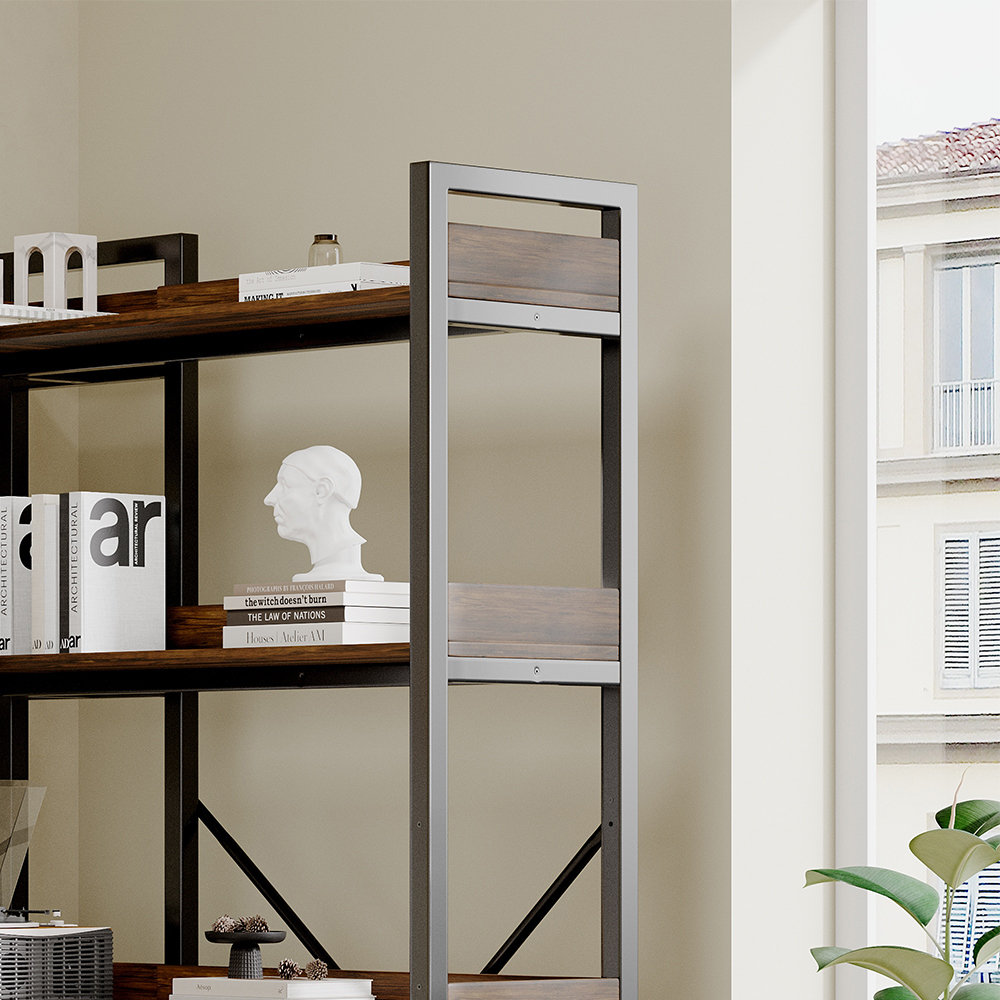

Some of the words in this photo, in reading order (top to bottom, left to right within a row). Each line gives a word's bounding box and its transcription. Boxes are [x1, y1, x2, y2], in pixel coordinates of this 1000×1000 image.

[90, 497, 161, 568] ar
[0, 506, 8, 616] ARCHITECTURAL
[70, 502, 78, 613] ARCHITECTURAL
[245, 598, 257, 607] the
[258, 597, 279, 606] witch
[280, 595, 307, 605] doesn't
[309, 595, 327, 604] burn
[248, 613, 262, 621] THE
[265, 612, 280, 621] LAW
[282, 612, 291, 620] OF
[294, 611, 326, 620] NATIONS
[68, 635, 81, 649] ar
[246, 632, 275, 643] Houses
[0, 638, 11, 651] ar
